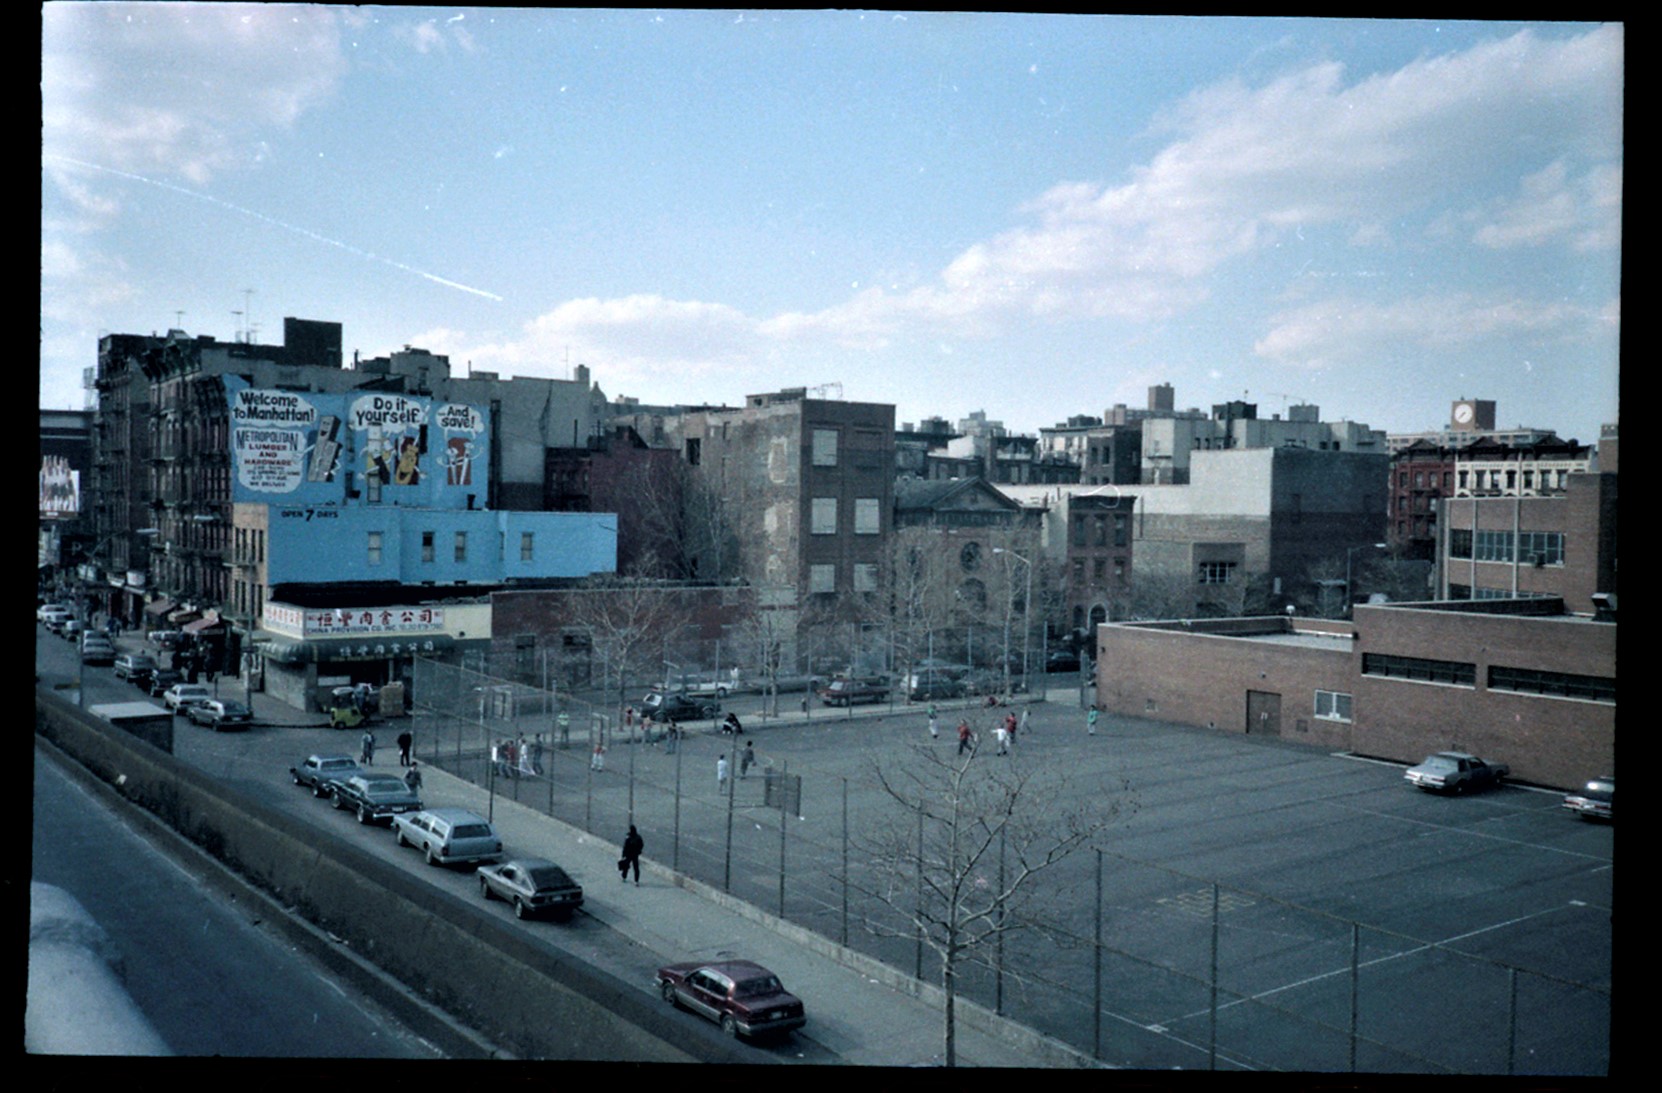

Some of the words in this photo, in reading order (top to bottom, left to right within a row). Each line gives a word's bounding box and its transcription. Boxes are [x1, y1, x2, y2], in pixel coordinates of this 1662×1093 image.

[240, 391, 298, 407] Welcome
[373, 396, 392, 410] Do
[396, 397, 408, 411] it
[233, 406, 246, 419] to
[247, 407, 314, 422] Manhattan!
[441, 415, 475, 428] save!
[236, 429, 299, 451] METROPOLITAN
[281, 510, 304, 518] OPEN
[306, 507, 314, 522] 7
[317, 510, 339, 518] DAYS
